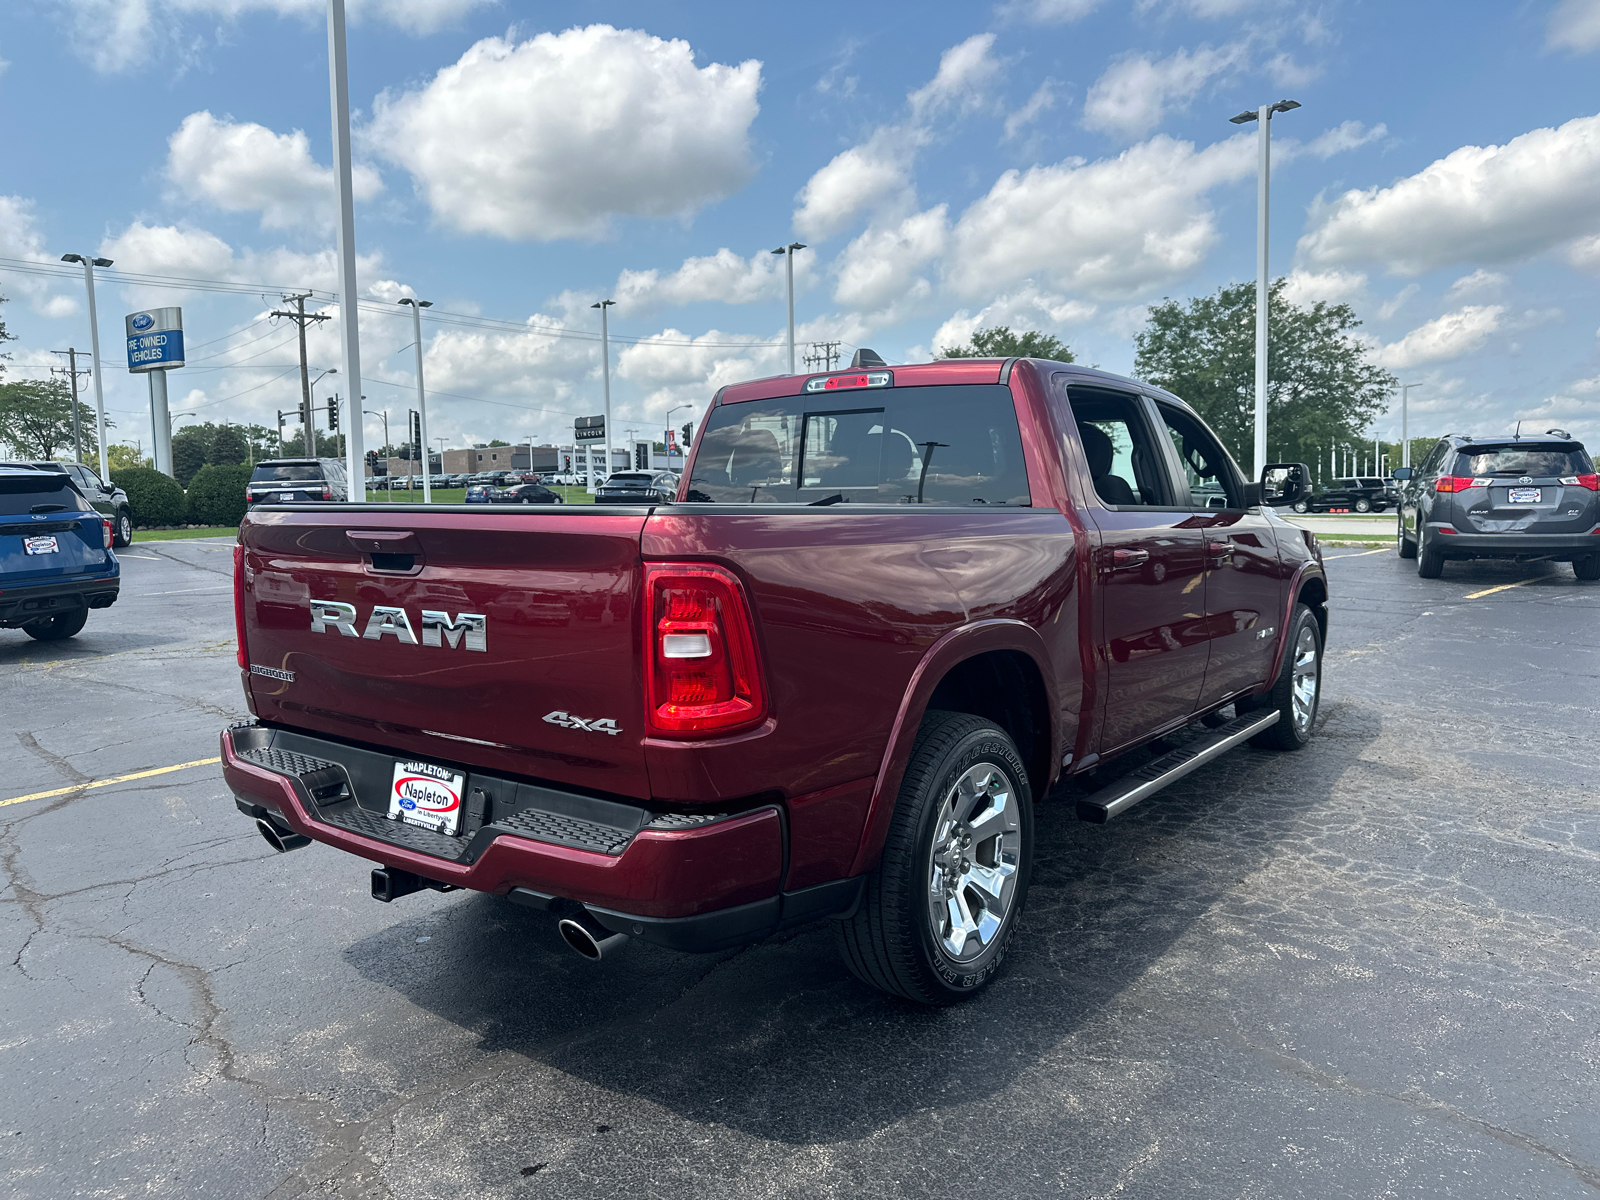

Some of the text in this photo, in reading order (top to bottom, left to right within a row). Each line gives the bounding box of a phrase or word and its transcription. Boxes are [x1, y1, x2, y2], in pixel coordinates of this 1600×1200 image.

[133, 315, 149, 328] Ford
[128, 335, 167, 351] PRE-OWNED
[131, 348, 162, 362] VEHICLES
[310, 599, 488, 652] RAM
[407, 762, 449, 780] NAPLETON
[404, 781, 449, 806] Napleton
[401, 799, 415, 809] Ford
[403, 816, 438, 831] LIBERTYVILLE
[423, 810, 452, 823] Libertyville
